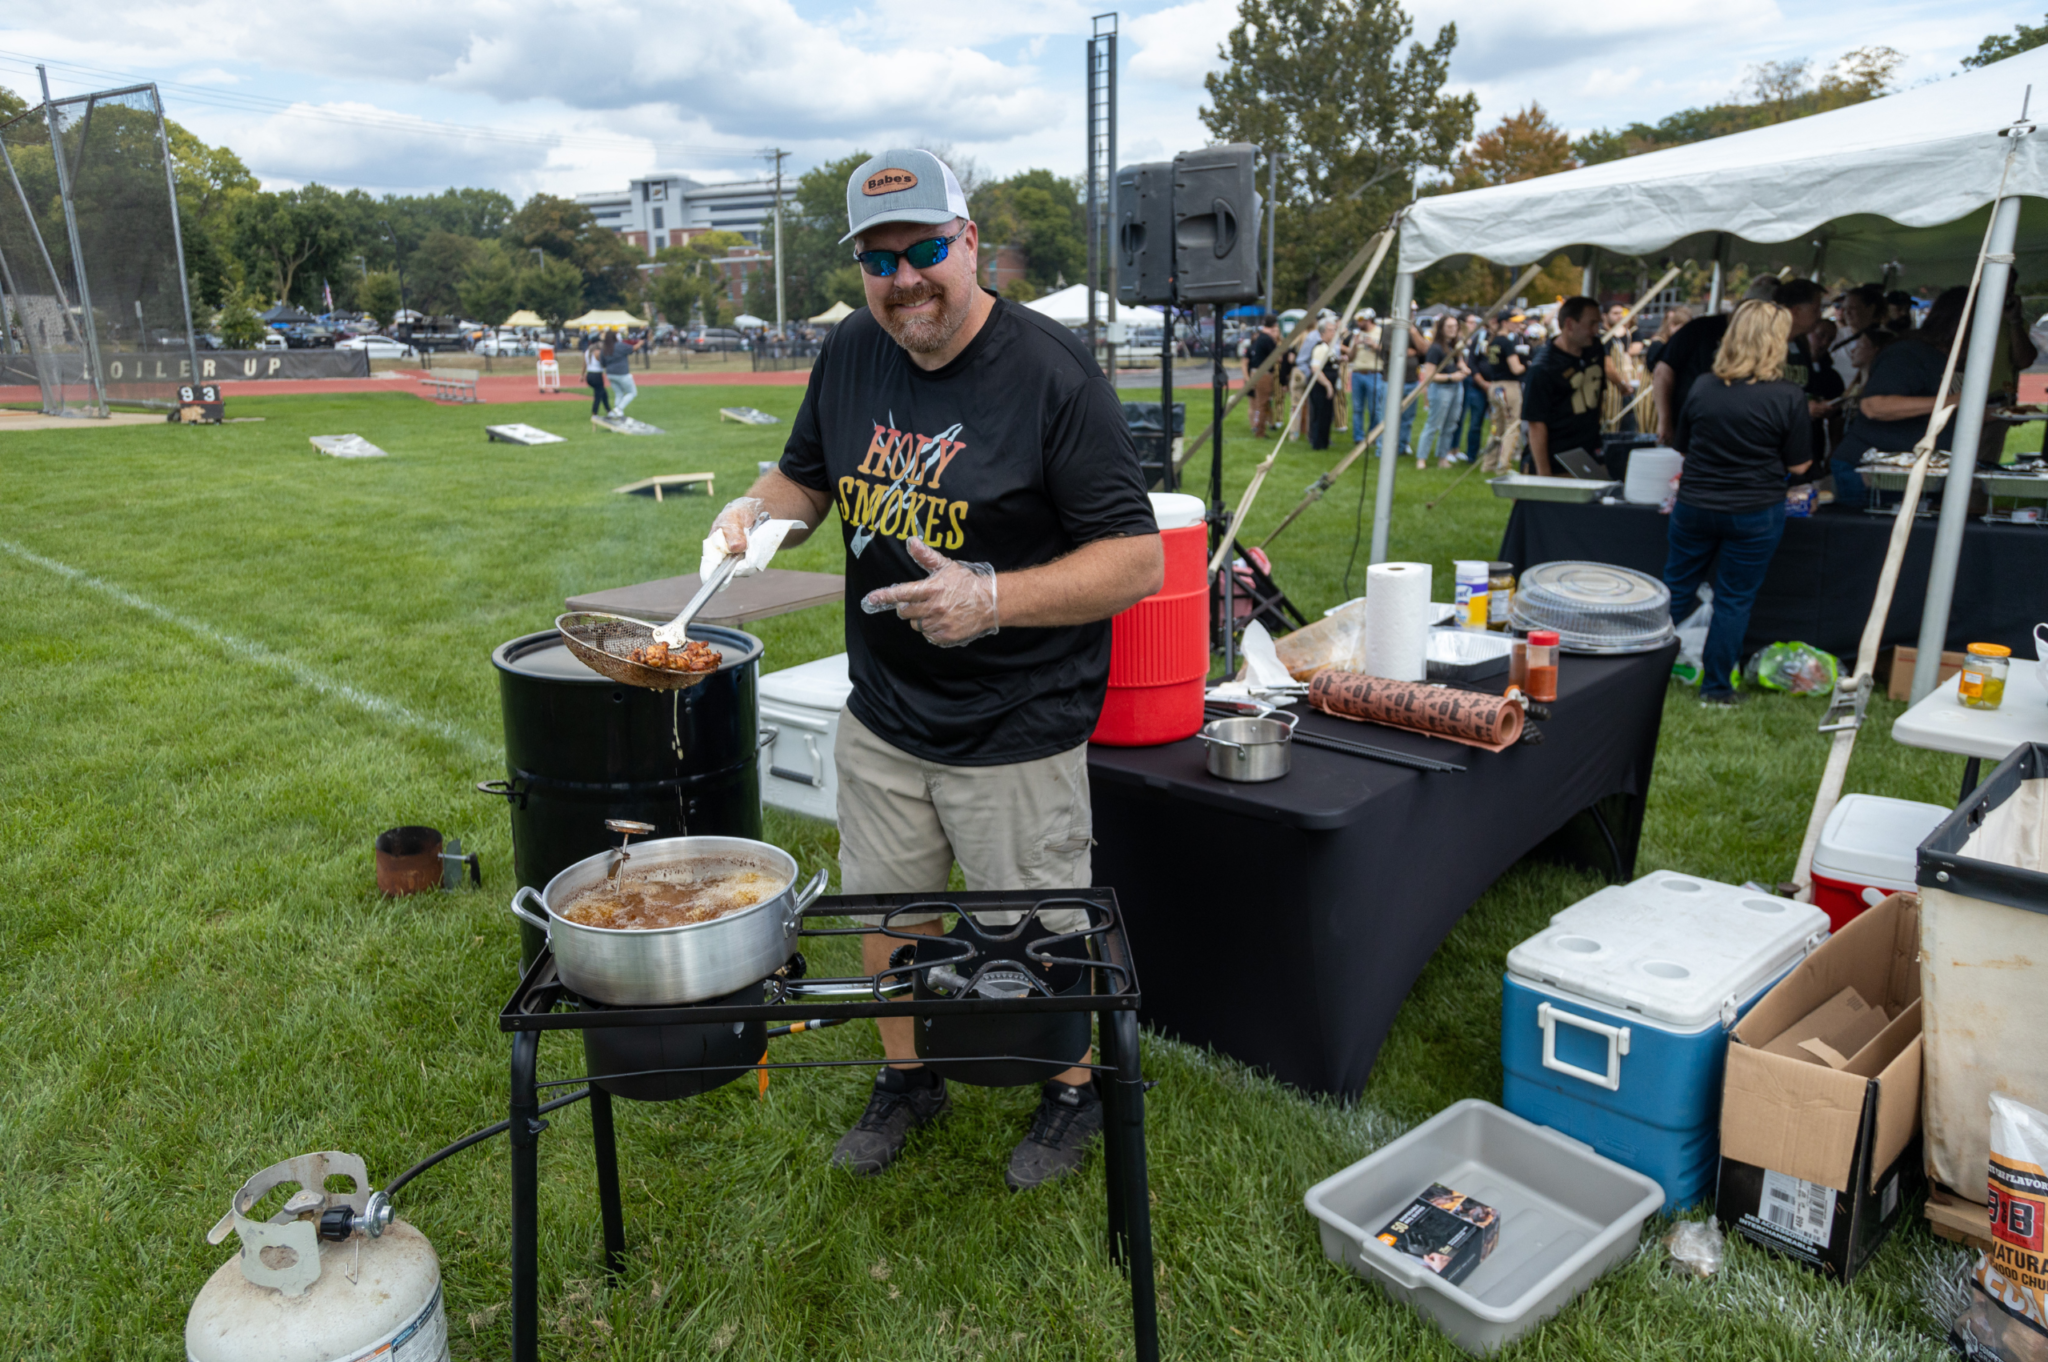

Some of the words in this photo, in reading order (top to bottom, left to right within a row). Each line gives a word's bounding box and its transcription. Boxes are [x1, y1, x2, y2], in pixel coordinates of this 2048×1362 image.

[868, 174, 912, 189] Babe's
[244, 357, 281, 377] UP
[857, 425, 967, 489] HOLY
[838, 476, 969, 550] SMOKES
[1987, 1186, 2035, 1238] B&B
[1738, 1216, 1819, 1255] INTERCHANGEABLES
[2021, 1273, 2048, 1291] CHU
